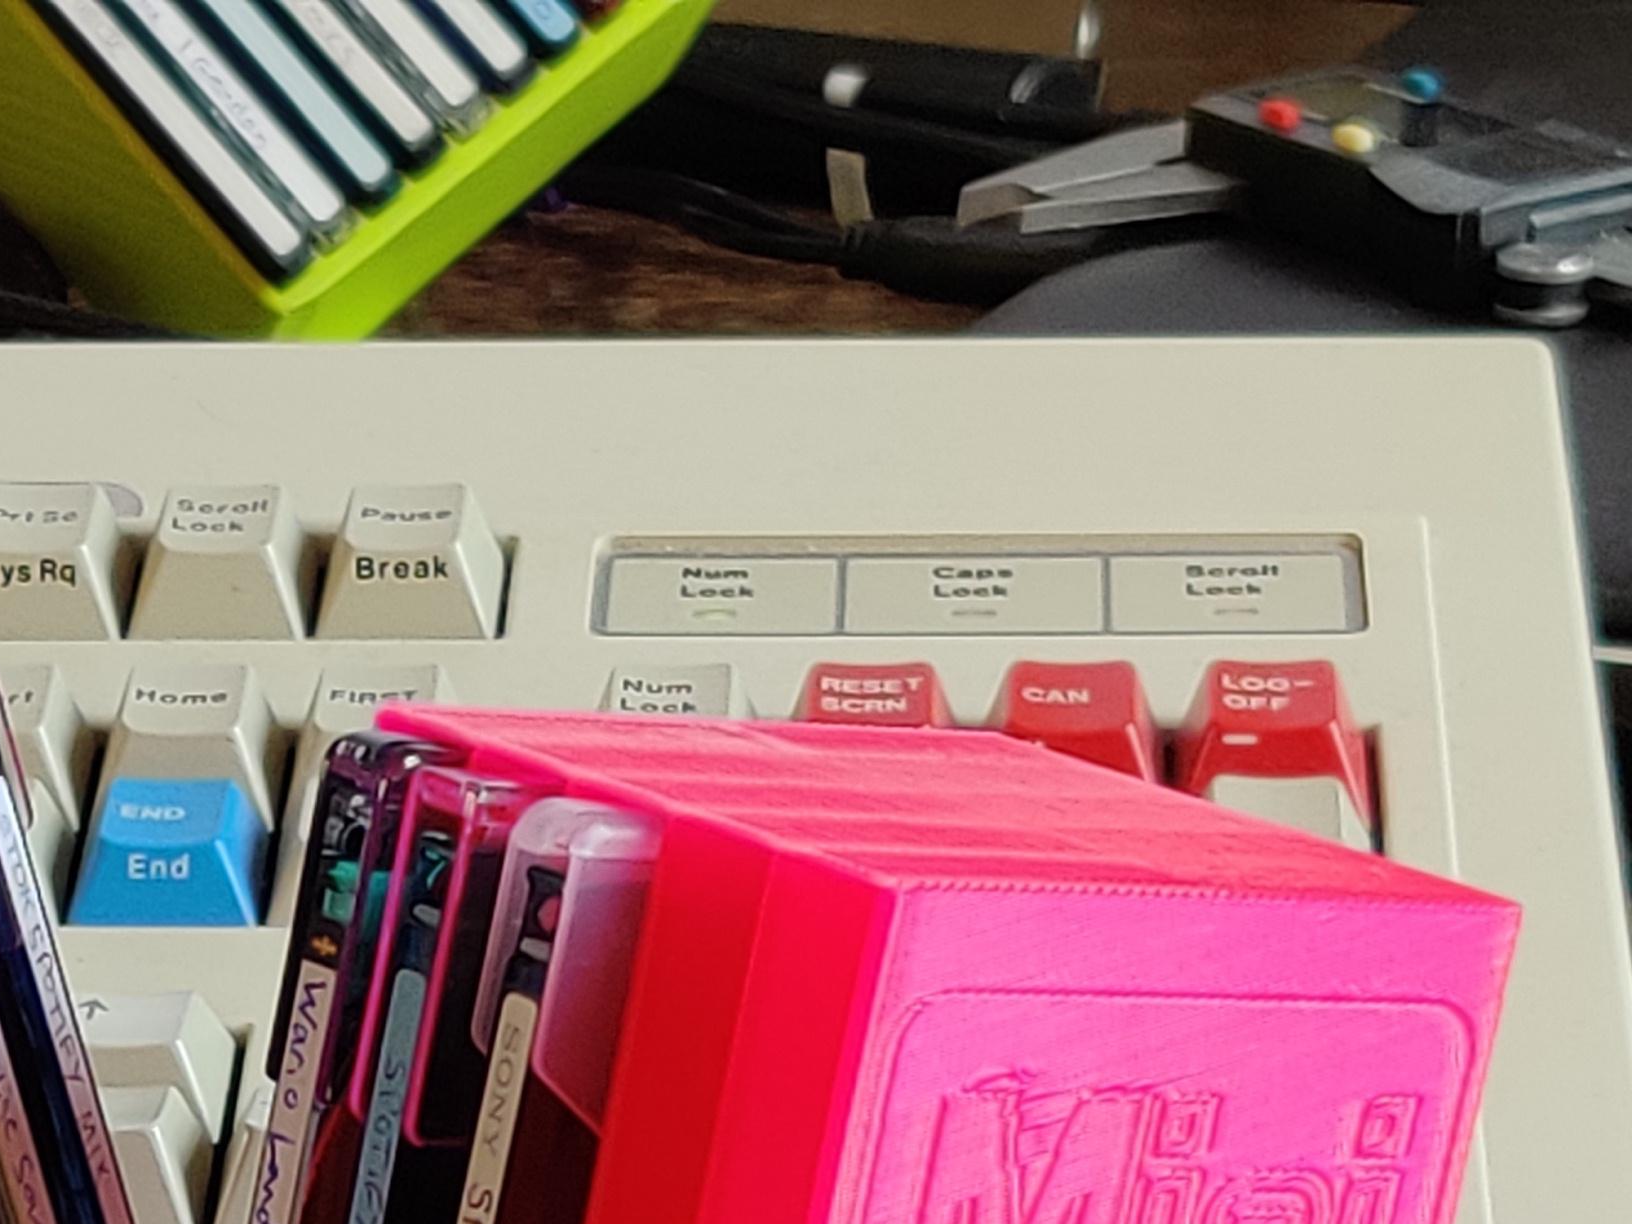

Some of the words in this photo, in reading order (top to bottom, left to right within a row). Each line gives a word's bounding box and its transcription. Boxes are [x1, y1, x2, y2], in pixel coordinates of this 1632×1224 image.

[176, 498, 269, 515] Scroll
[361, 507, 453, 522] Pause
[171, 517, 244, 533] Lock
[355, 555, 449, 580] Break
[681, 567, 749, 580] Num
[932, 566, 1014, 580] Caps
[1185, 563, 1280, 578] Scroll
[680, 585, 754, 598] Lock
[934, 584, 1008, 598] Lock
[1185, 583, 1263, 596] Lock
[622, 679, 693, 694] Num
[820, 676, 925, 693] RESET
[134, 688, 228, 705] Home
[1021, 686, 1090, 705] CAN
[1222, 695, 1290, 711] OFF
[620, 697, 697, 713] Lock
[820, 697, 908, 713] SCRN
[119, 804, 187, 821] END
[127, 853, 190, 881] End
[283, 979, 326, 1109] Wario
[481, 1023, 520, 1155] SONY
[79, 1110, 110, 1175] MIX
